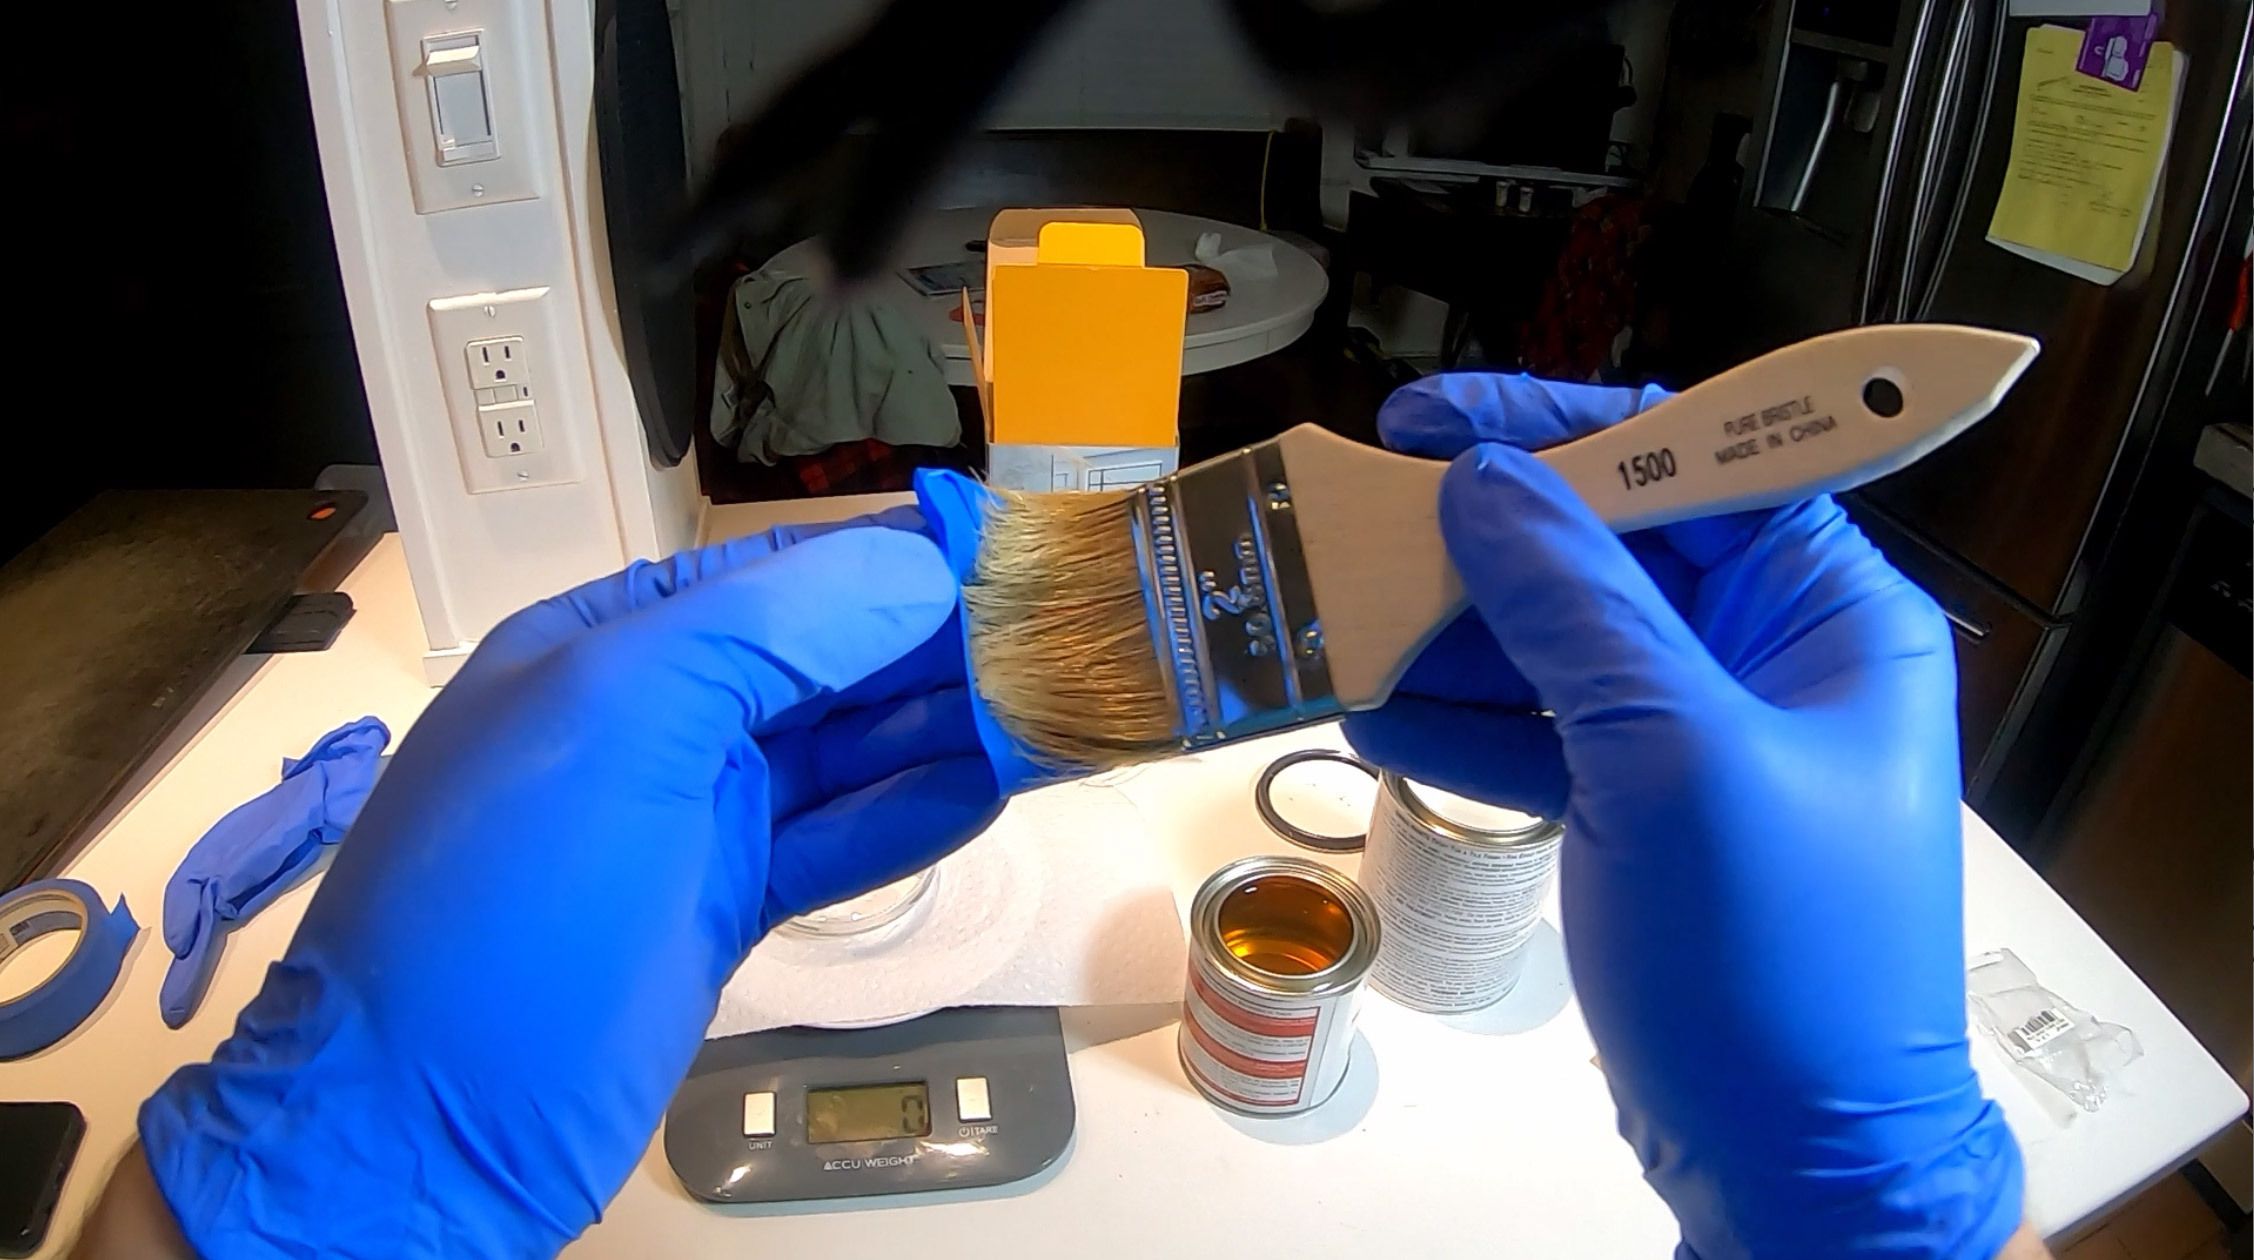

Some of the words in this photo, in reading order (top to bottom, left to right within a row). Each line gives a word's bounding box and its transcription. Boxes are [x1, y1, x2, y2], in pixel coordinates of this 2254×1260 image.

[1723, 412, 1760, 437] PURE
[1761, 395, 1816, 427] BRISTLE
[1715, 438, 1760, 465] MADE
[1766, 432, 1783, 449] IN
[1789, 414, 1837, 442] CHINA
[1617, 447, 1678, 491] 1500
[974, 1125, 999, 1136] TARE
[748, 1140, 772, 1150] UNIT
[864, 1154, 916, 1168] WEIGHT
